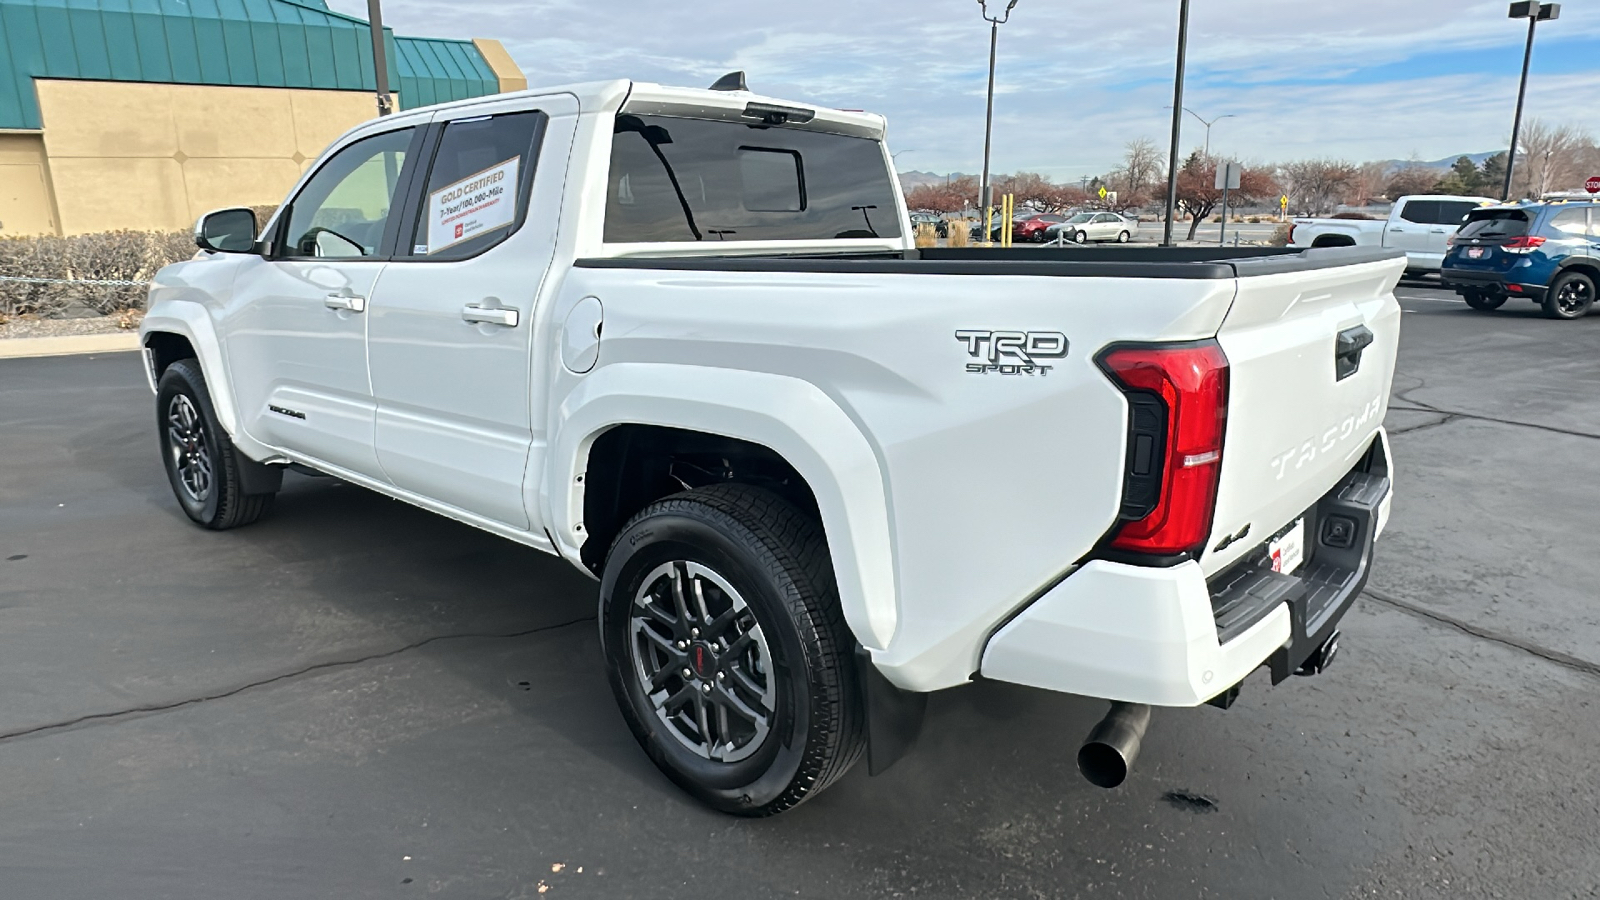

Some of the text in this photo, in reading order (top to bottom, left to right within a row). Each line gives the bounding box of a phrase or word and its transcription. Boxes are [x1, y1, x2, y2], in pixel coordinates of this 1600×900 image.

[440, 186, 504, 219] 7-Year/100,000-Mile
[441, 170, 504, 205] GOLD CERTIFIED
[954, 329, 1070, 366] TRD
[965, 363, 1053, 376] SPORT
[1271, 394, 1381, 481] TACOMA
